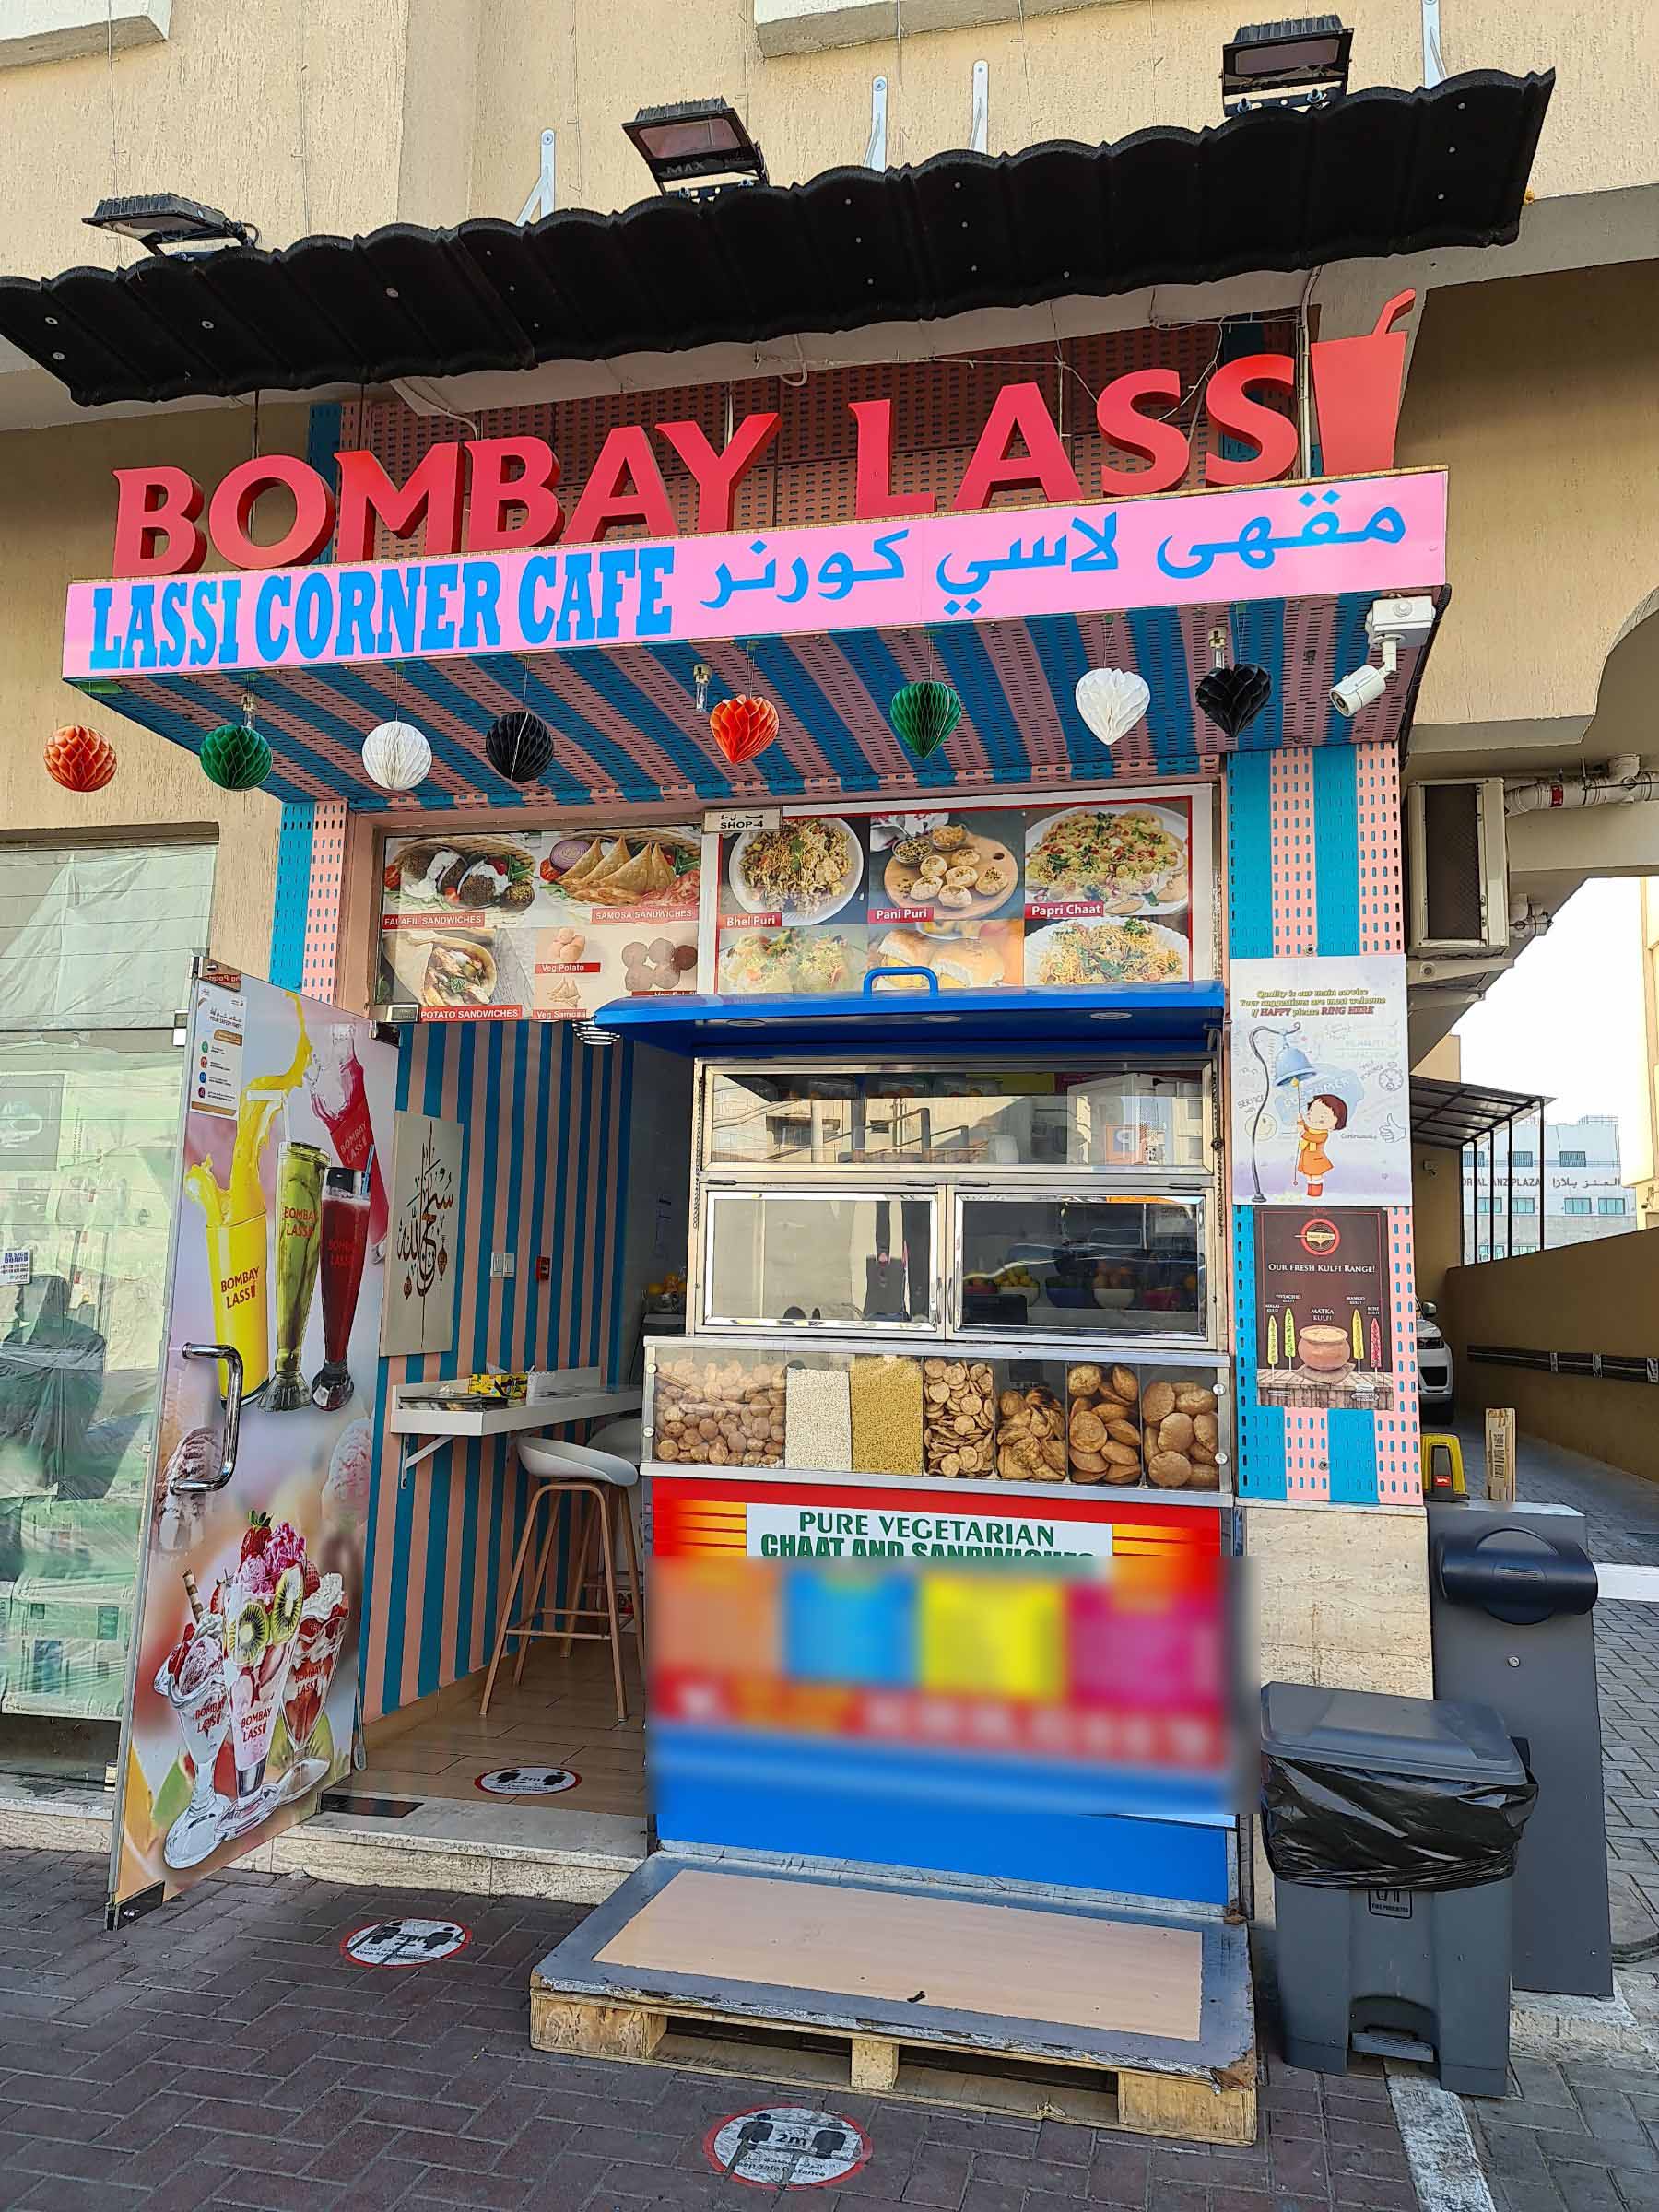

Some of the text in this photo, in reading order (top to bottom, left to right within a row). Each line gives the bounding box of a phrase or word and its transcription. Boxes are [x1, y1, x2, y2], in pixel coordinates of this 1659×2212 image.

[112, 412, 782, 578] BOMBAY
[700, 490, 1406, 615] مقهى لاسي كورنر
[89, 546, 674, 670] LASSI CORNER CAFE
[720, 820, 763, 829] SHOP-4
[596, 909, 693, 920] SAMOSA SANDWICHES
[877, 907, 927, 920] Pani Puri
[1031, 903, 1101, 918] Papri Chaat
[384, 914, 482, 925] FALAFIL SANDWICHES
[726, 914, 776, 926] Bhel Puri
[542, 963, 585, 973] Veg Potato
[420, 1008, 518, 1019] POTATO SANDWICHES
[536, 1011, 553, 1020] Veg
[1260, 1007, 1291, 1017] HAPPY
[1321, 1006, 1347, 1016] RING
[1347, 1006, 1375, 1015] HERE
[1512, 1177, 1540, 1187] PLAZA
[283, 1206, 317, 1222] BOMBAY
[1268, 1263, 1375, 1273] OUR FRESH KULFI RANGE!
[220, 1266, 260, 1294] BOMBAY
[799, 1512, 1054, 1547] PURE VEGETARIAN
[760, 1533, 845, 1557] CHAAT
[241, 1707, 272, 1729] BOMBAY
[776, 2133, 807, 2147] 2m
